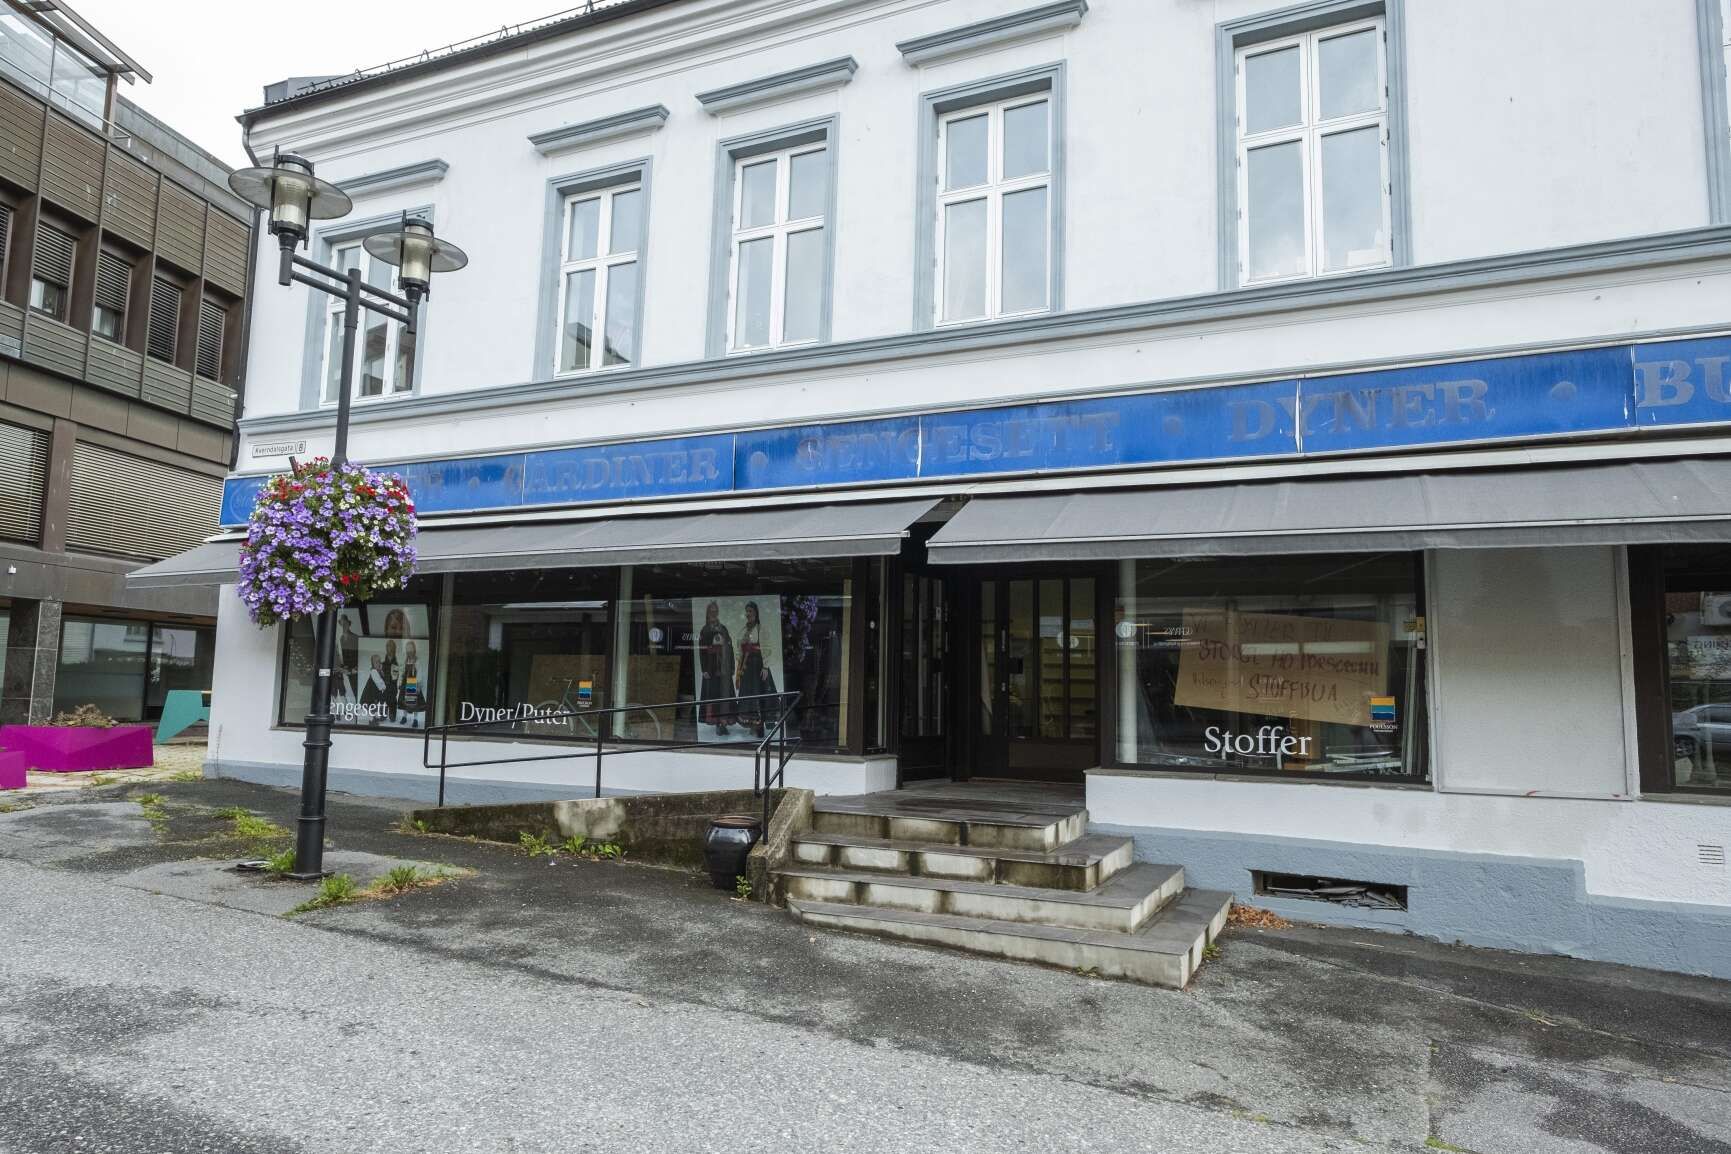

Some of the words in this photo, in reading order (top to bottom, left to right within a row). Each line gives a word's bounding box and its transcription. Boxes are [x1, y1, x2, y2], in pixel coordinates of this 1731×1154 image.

[505, 447, 720, 496] GARDINER
[1227, 377, 1496, 443] DYNER
[329, 701, 388, 721] engesett
[1204, 725, 1312, 756] Stoffer
